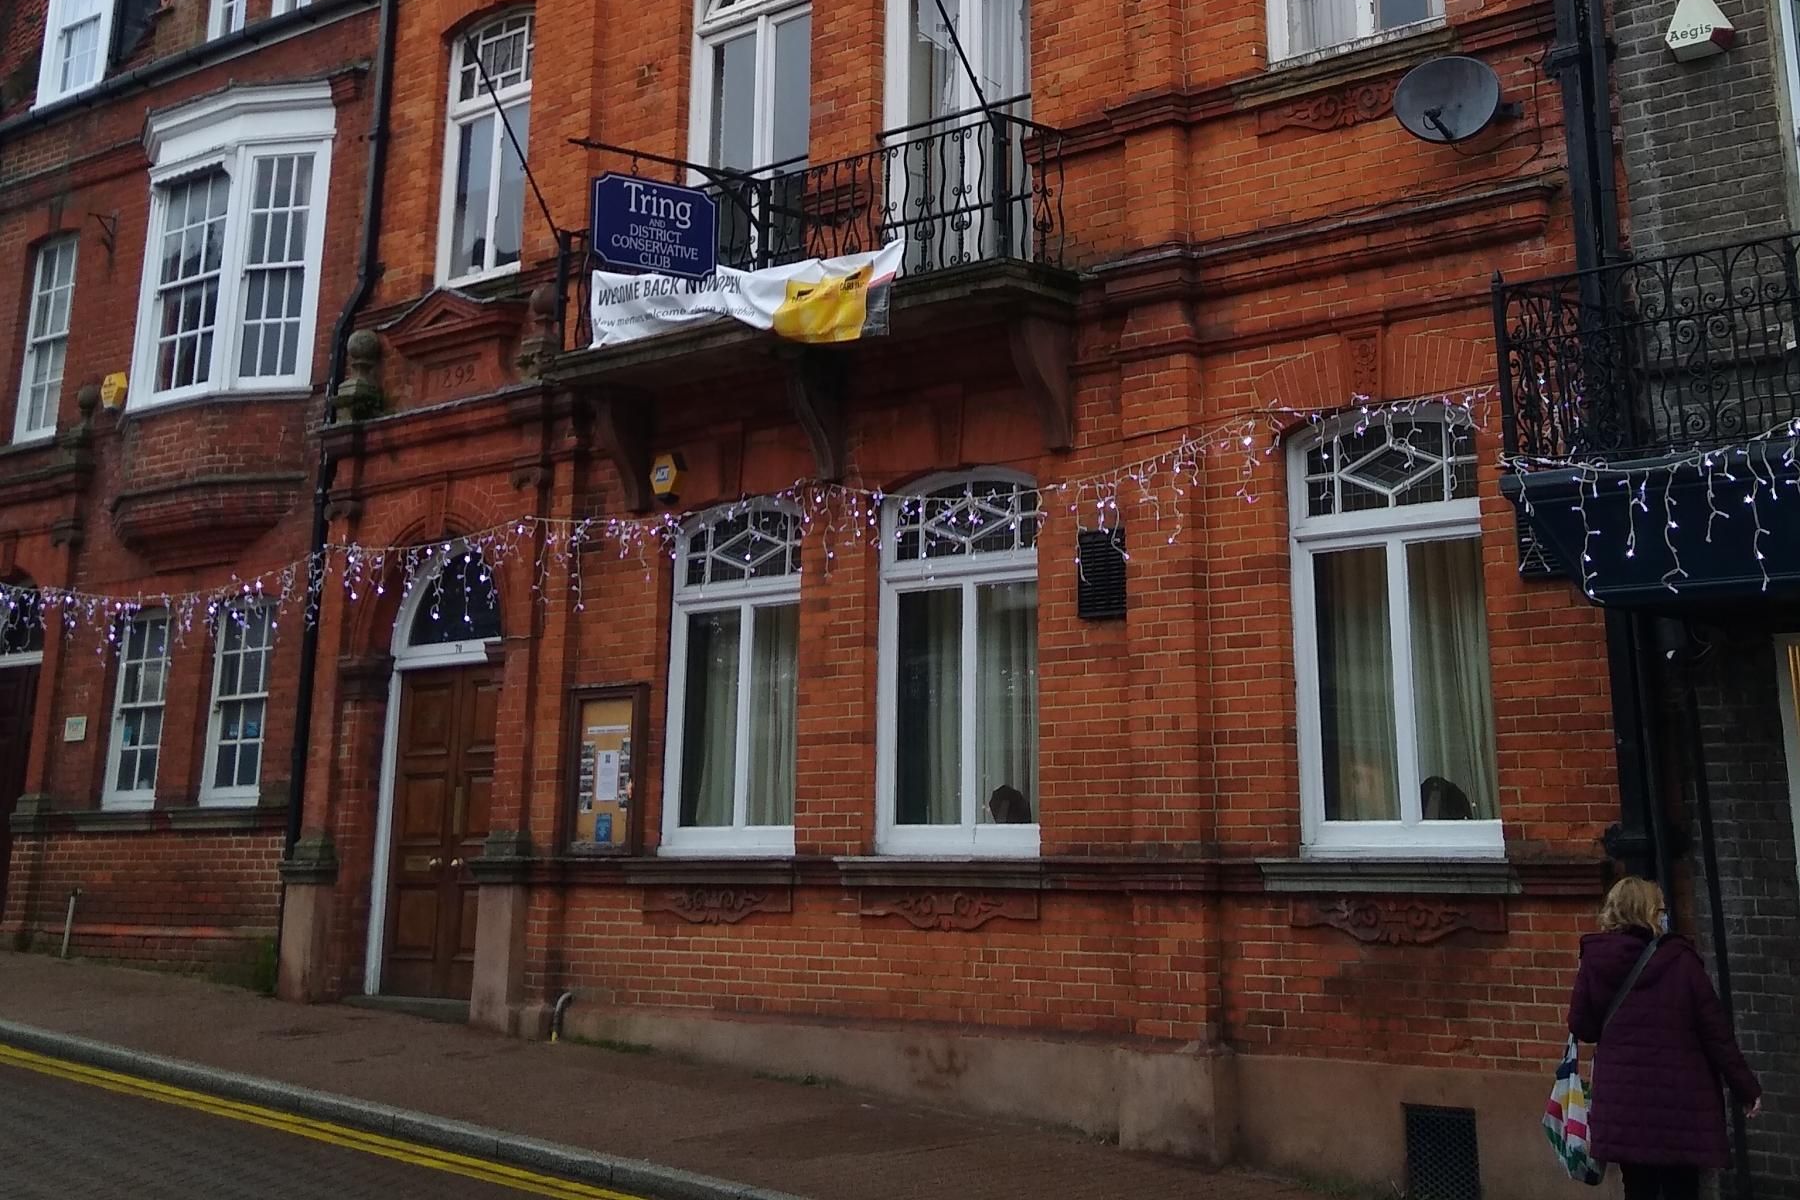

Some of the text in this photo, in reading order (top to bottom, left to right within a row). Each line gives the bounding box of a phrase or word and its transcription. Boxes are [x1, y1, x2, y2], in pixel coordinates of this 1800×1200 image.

[1669, 23, 1712, 42] Aegis
[623, 181, 692, 229] Tring
[630, 223, 682, 244] DISTRICT
[649, 218, 666, 229] AND
[611, 234, 699, 261] CONSERVATIVE
[640, 252, 671, 269] CLUB
[598, 281, 640, 306] WEOME
[642, 277, 678, 298] BACK
